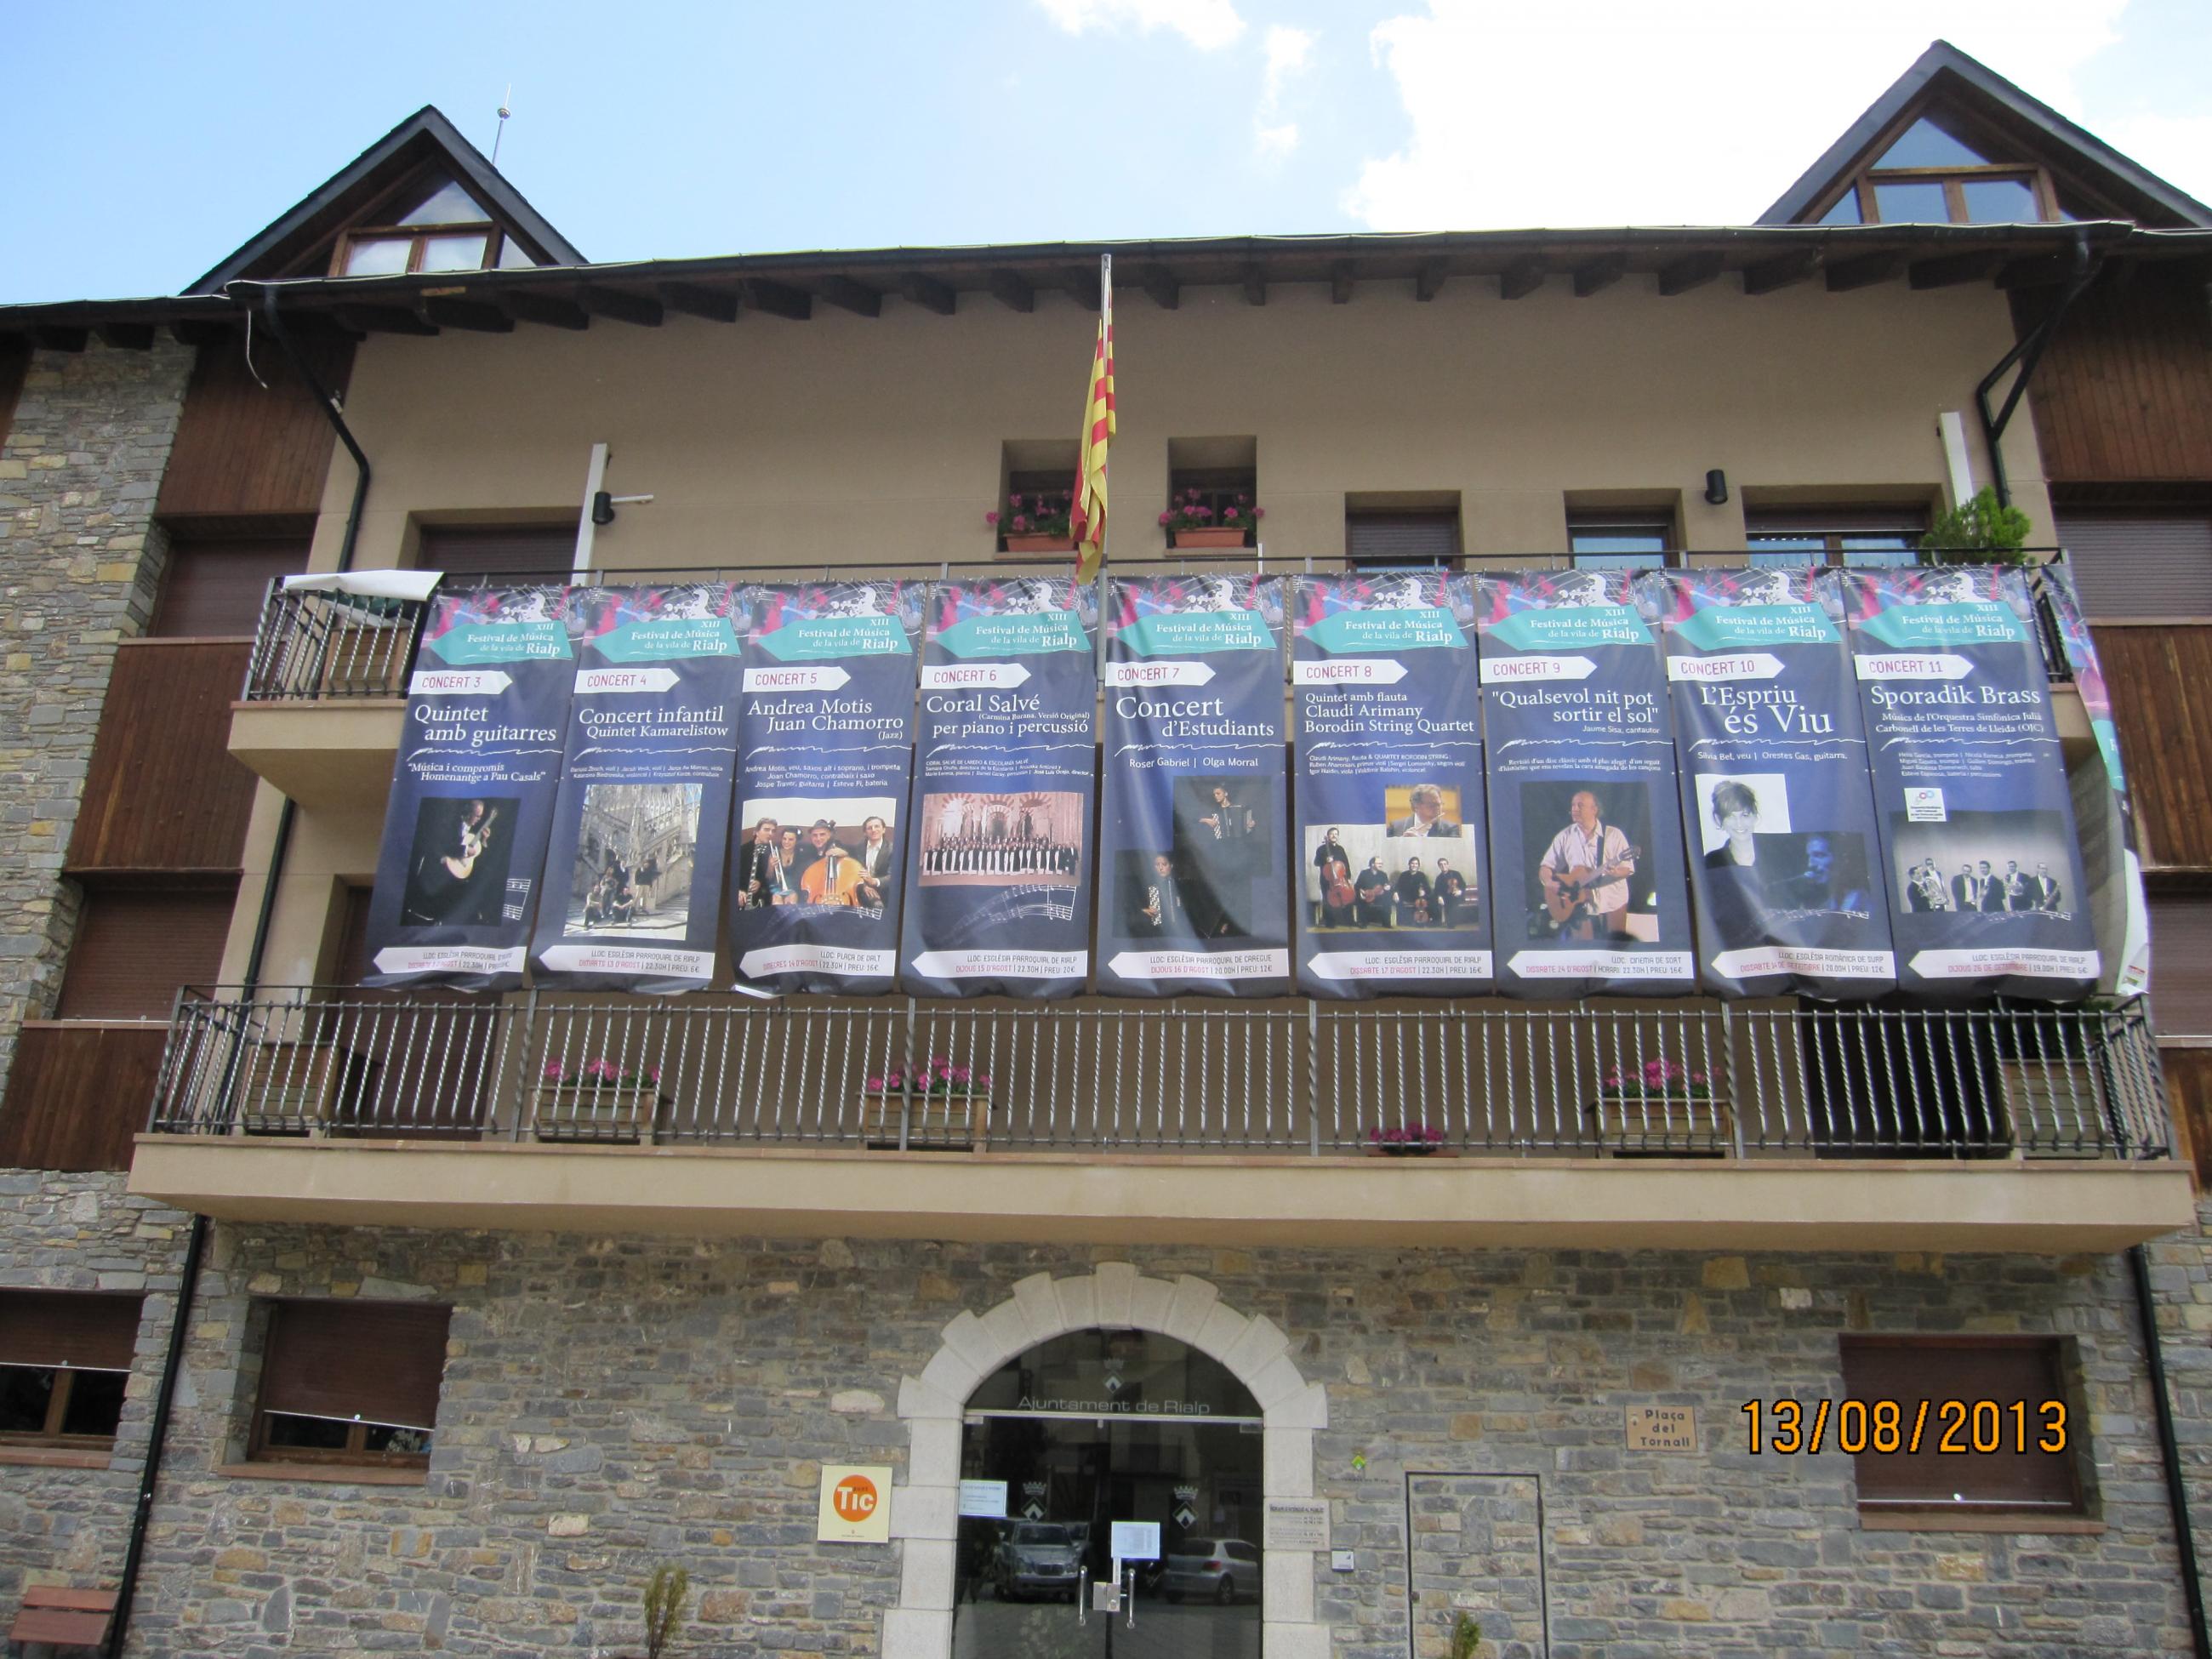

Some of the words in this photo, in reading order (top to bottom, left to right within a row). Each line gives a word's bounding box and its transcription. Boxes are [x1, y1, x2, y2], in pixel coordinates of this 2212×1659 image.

[1791, 606, 1810, 614] XIII
[1345, 621, 1386, 630] Festival
[1389, 621, 1401, 630] de
[1405, 620, 1442, 629] Música
[1576, 619, 1588, 628] de
[1590, 619, 1628, 627] Música
[1716, 616, 1757, 625] Festival
[1776, 615, 1815, 625] Música
[686, 630, 720, 639] Música
[854, 628, 890, 636] Música
[976, 626, 1015, 635] Festival
[1033, 624, 1068, 633] Música
[1156, 624, 1196, 633] Festival
[1200, 624, 1211, 632] de
[1602, 628, 1639, 641] Rialp
[1788, 626, 1826, 641] Rialp
[1976, 625, 2015, 639] Rialp
[1042, 634, 1077, 647] Rialp
[1225, 633, 1261, 647] Rialp
[1416, 630, 1452, 644] Rialp
[526, 643, 560, 657] Rialp
[693, 640, 727, 653] Rialp
[863, 639, 898, 652] Rialp
[1118, 667, 1168, 681] CONCERT
[1172, 668, 1179, 677] 7
[1306, 666, 1360, 678] CONCERT
[1365, 666, 1371, 676] 8
[1493, 662, 1548, 676] CONCERT
[1554, 663, 1560, 673] 9
[1681, 661, 1735, 675] CONCERT
[1741, 660, 1754, 672] 10
[1869, 661, 1924, 674] CONCERT
[1930, 661, 1943, 672] 11
[422, 677, 470, 688] CONCERT
[474, 677, 481, 687] 3
[587, 675, 636, 687] CONCERT
[641, 676, 647, 685] 4
[755, 673, 806, 686] CONCERT
[810, 673, 817, 684] 5
[934, 670, 985, 682] CONCERT
[989, 670, 996, 681] 6
[926, 694, 982, 712] Coral
[989, 694, 1040, 712] Salvé
[1305, 693, 1348, 704] Quintet
[1350, 692, 1373, 701] amb
[1377, 692, 1407, 701] flauta
[1492, 688, 1589, 709] "Qualsevol
[1595, 691, 1619, 704] nit
[1624, 693, 1653, 710] pot
[1701, 685, 1797, 710] L'Espriu
[1871, 685, 1975, 710] Sporadik
[1980, 686, 2041, 704] Brass
[747, 699, 814, 715] Andrea
[820, 698, 872, 714] Motis
[1116, 697, 1223, 719] Concert
[1306, 704, 1353, 718] Claudi
[1359, 705, 1422, 719] Arimany
[415, 704, 488, 723] Quintet
[579, 709, 653, 724] Concert
[658, 706, 723, 722] infantil
[1553, 709, 1602, 721] sortir
[1608, 707, 1621, 721] el
[1628, 707, 1658, 723] sol"
[1725, 706, 1758, 733] és
[1767, 704, 1833, 733] Viu
[767, 716, 806, 734] Juan
[812, 715, 904, 730] Chamorro
[933, 725, 961, 738] per
[961, 721, 1004, 738] piano
[1010, 722, 1014, 734] i
[1018, 720, 1088, 737] percussió
[1162, 719, 1274, 737] d'Estudiants
[1305, 719, 1364, 733] Borodin
[1369, 720, 1413, 735] String
[1417, 719, 1474, 733] Quartet
[425, 724, 466, 741] amb
[471, 725, 556, 747] guitarres
[587, 727, 636, 738] Quintet
[640, 725, 728, 736] Kamarelistow
[878, 732, 903, 740] (Jazz)
[453, 762, 505, 772] compromís
[1129, 759, 1154, 768] Roser
[1157, 757, 1189, 766] Gabriel
[1203, 757, 1224, 767] Olga
[491, 772, 508, 781] Pau
[1018, 1396, 1131, 1412] Ajuntament
[1136, 1400, 1159, 1412] de
[1165, 1400, 1210, 1416] Rialp
[1645, 1409, 1685, 1421] Plaça
[1652, 1423, 1674, 1433] del
[1640, 1437, 1690, 1446] Tornall
